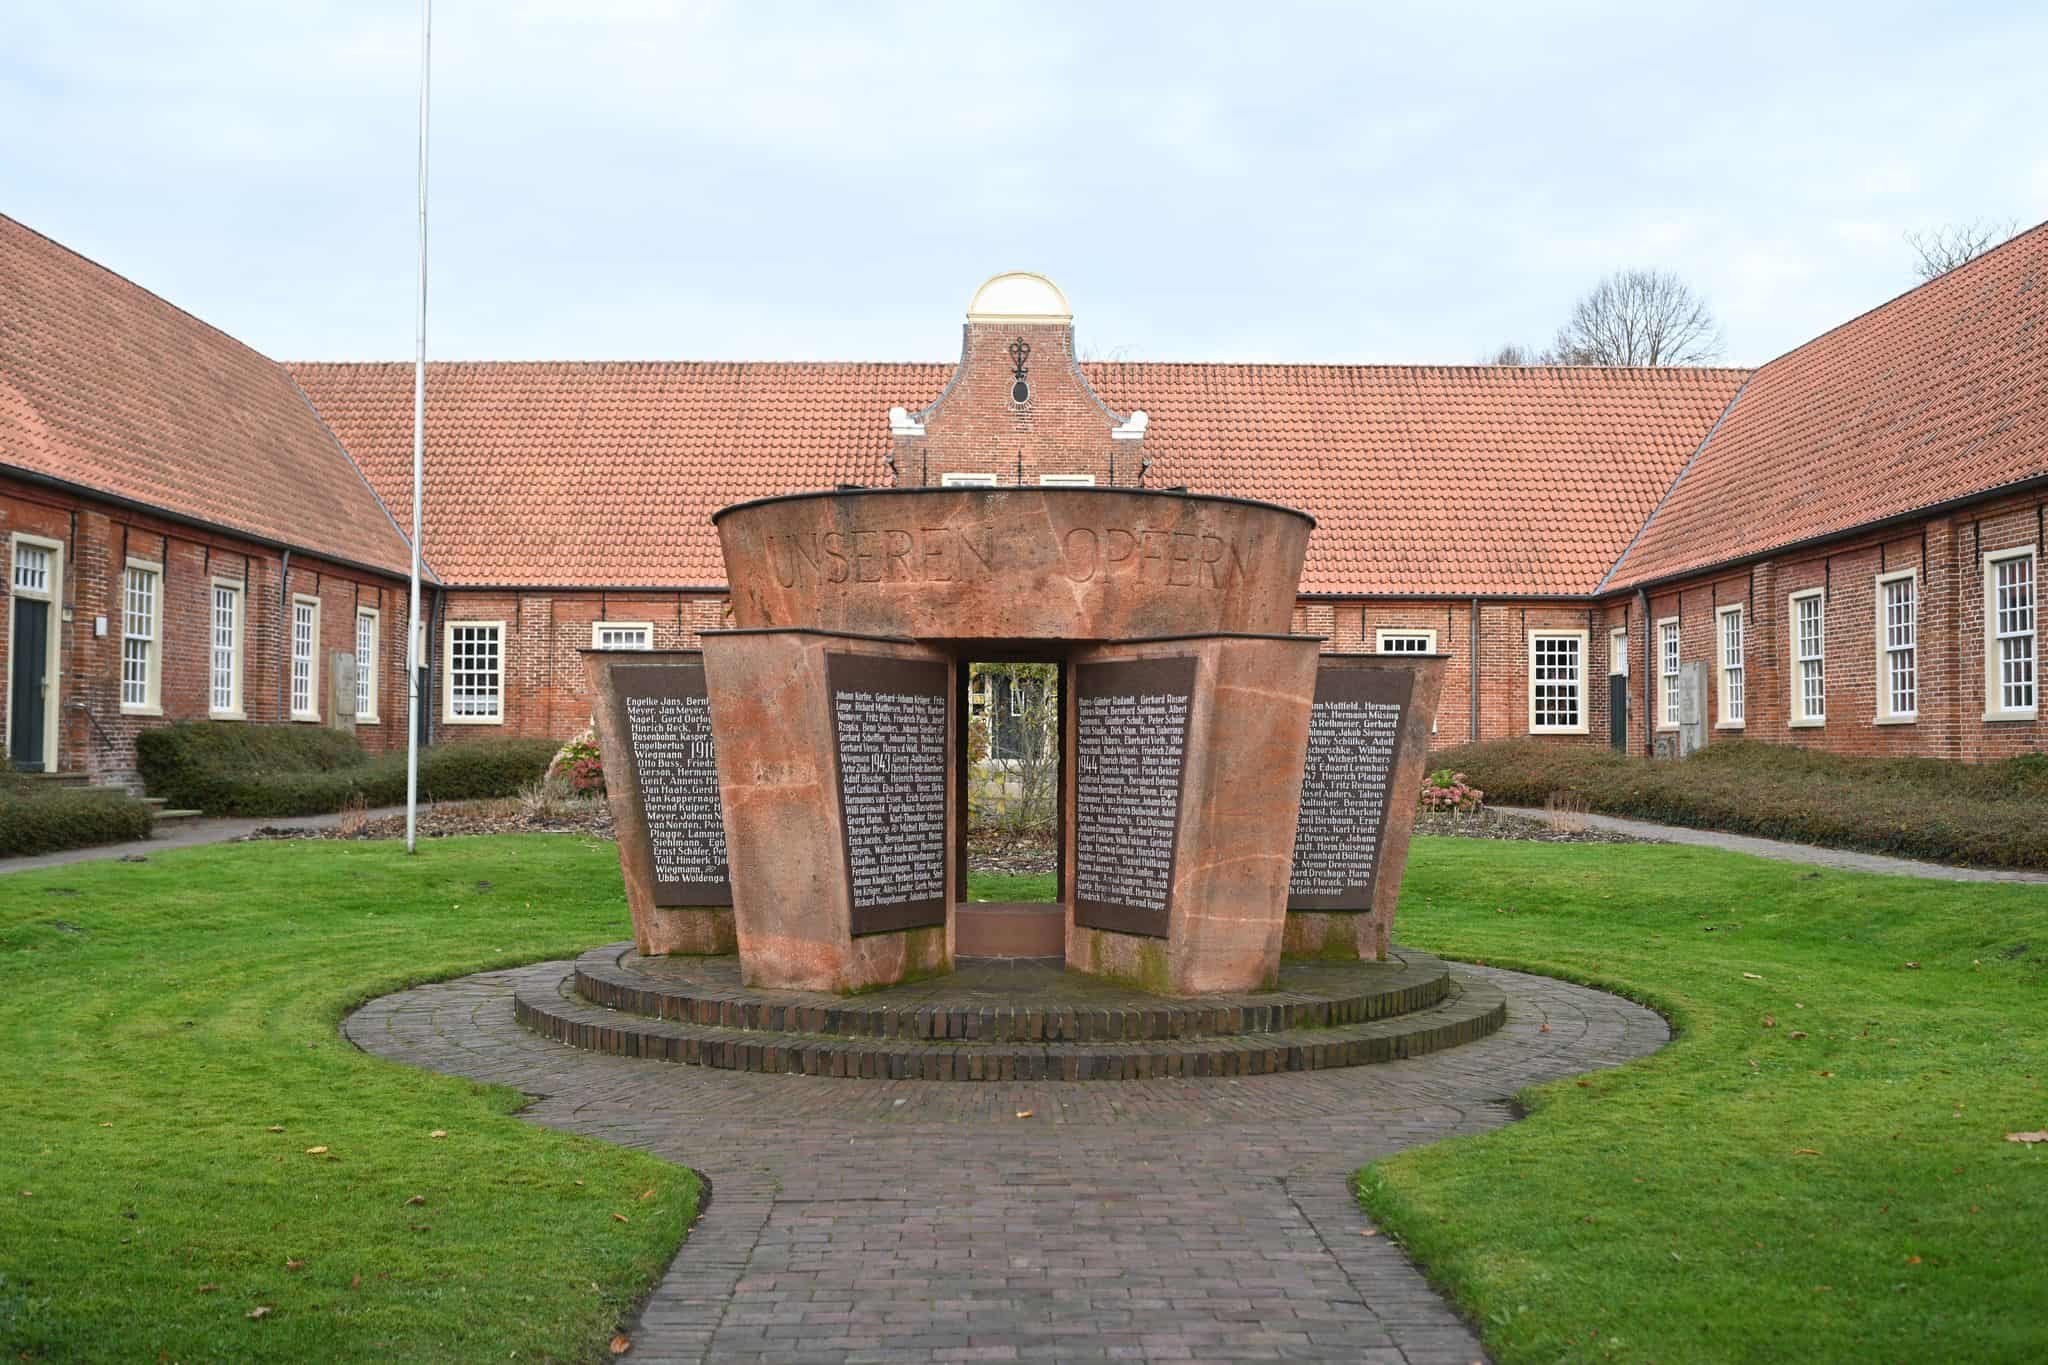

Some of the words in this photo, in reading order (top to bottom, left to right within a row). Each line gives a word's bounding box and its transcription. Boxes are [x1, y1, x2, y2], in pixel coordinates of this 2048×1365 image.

[769, 527, 994, 589] UNSEREN
[1064, 527, 1256, 588] OPFERN
[626, 696, 659, 706] Engelke
[659, 706, 674, 714] Jan
[1365, 701, 1400, 711] Hermann
[661, 714, 682, 723] Gerd
[1332, 710, 1368, 719] Hermann
[631, 723, 664, 732] Hinrich
[1364, 719, 1397, 728] Gerhard
[680, 732, 708, 742] Kasper
[1372, 737, 1394, 746] Adolf
[1358, 746, 1393, 755] Wilhelm
[635, 751, 682, 760] Wiegmann
[642, 785, 659, 794] Jan
[693, 785, 712, 793] Gerd
[644, 794, 661, 803] Jan
[1344, 798, 1383, 808] Bernhard
[645, 803, 677, 811] Berend
[1347, 834, 1376, 843] Johann
[654, 847, 676, 856] Ernst
[658, 873, 679, 882] Ubbo
